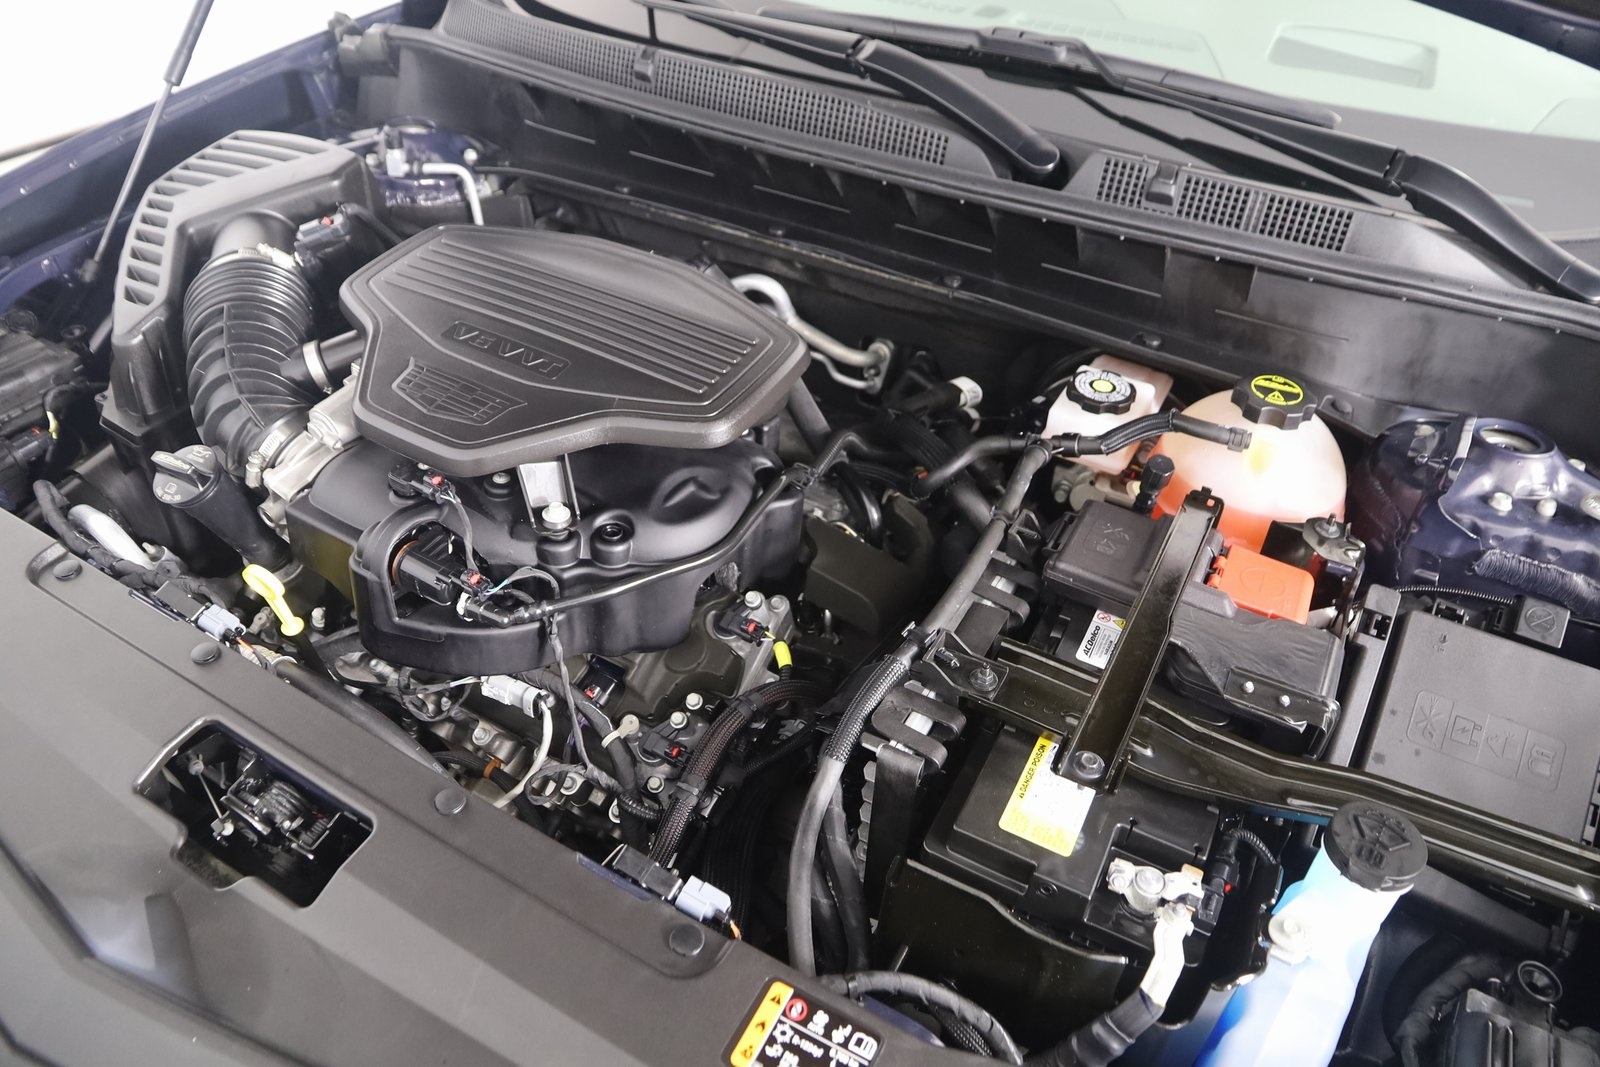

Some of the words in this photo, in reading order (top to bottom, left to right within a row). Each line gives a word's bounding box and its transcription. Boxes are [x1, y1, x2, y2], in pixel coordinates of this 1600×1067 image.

[453, 325, 497, 349] V6
[498, 340, 564, 373] VVT
[1083, 625, 1101, 656] ACDelco
